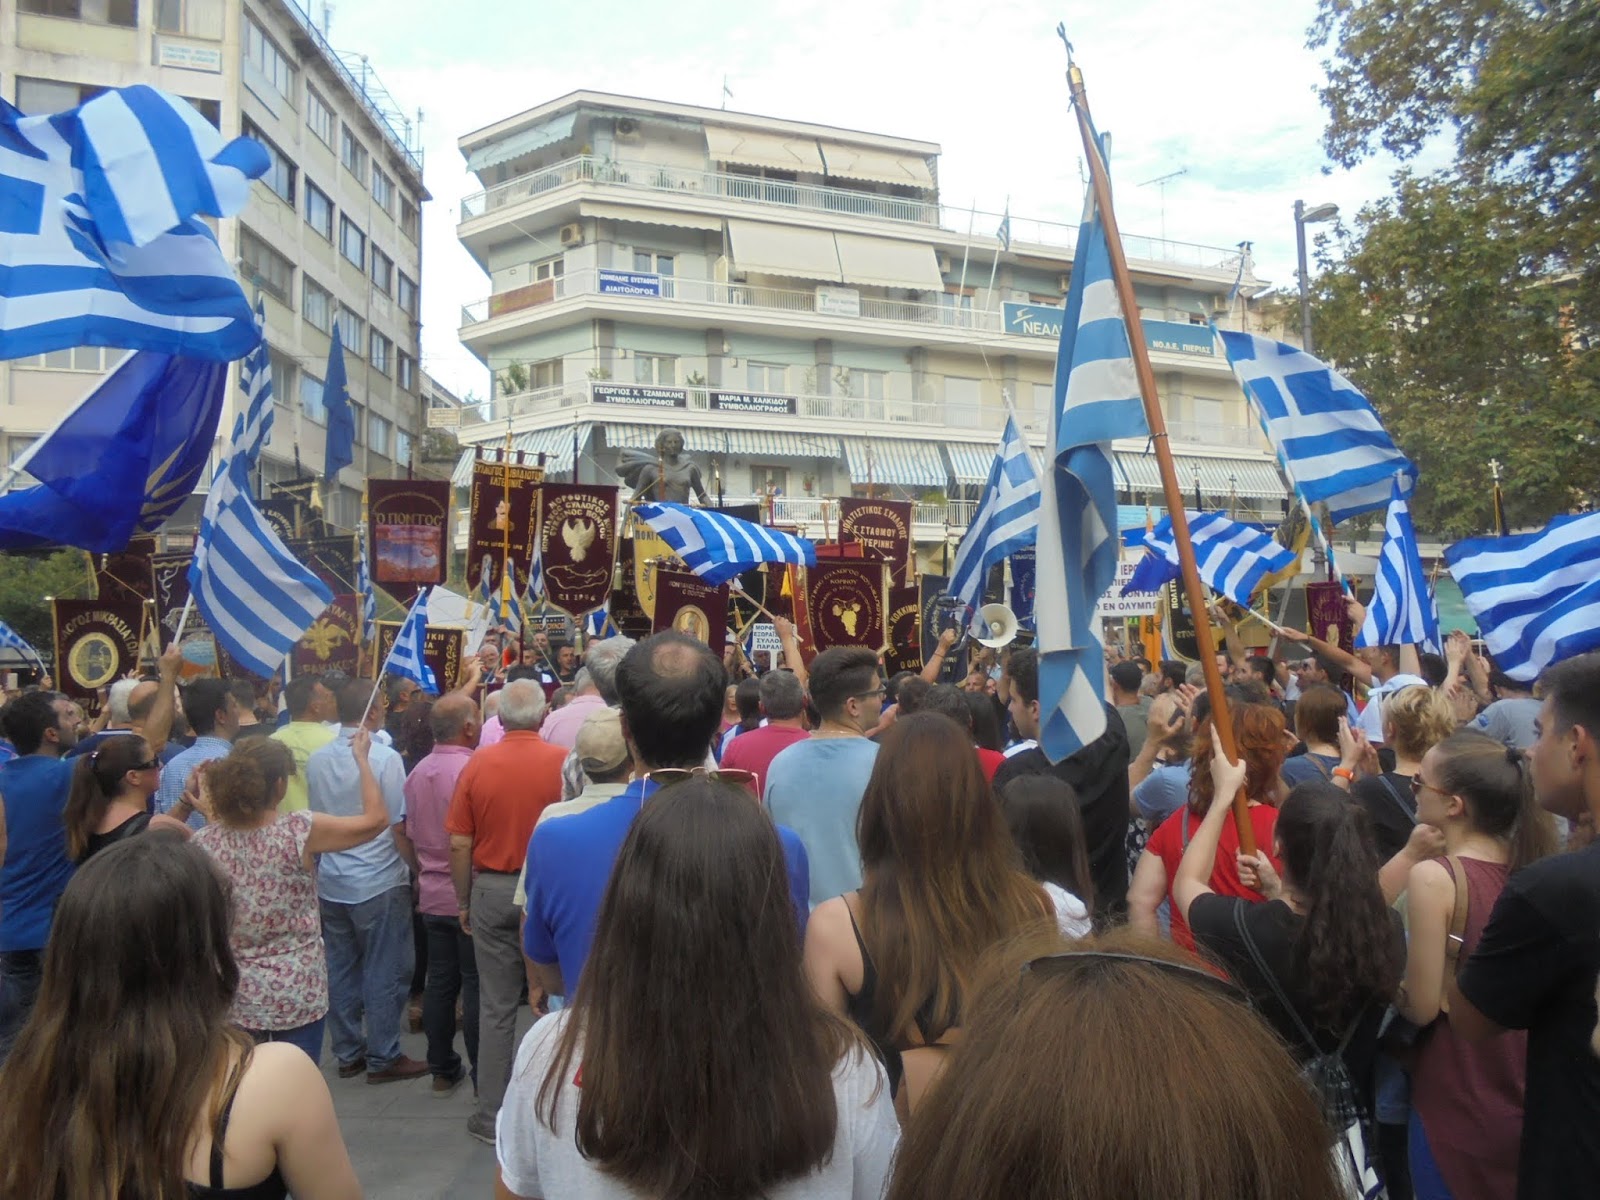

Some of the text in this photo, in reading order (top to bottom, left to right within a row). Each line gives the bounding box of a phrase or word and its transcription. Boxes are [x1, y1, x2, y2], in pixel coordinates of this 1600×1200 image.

[605, 285, 655, 295] ΔΙΑΙΤΟΛΟΓΟΣ
[1023, 320, 1062, 336] ΝΕΑΔ
[1182, 344, 1211, 354] ΠΙΕΡΙΑΣ
[594, 386, 631, 396] ΓΕΩΡΓΙΟΣ
[642, 389, 685, 399] ΤΖΑΜΑΚΛΗΣ
[605, 396, 675, 407] ΣΥΜΒΟΛΑΙΟΓΡΑΦΟΣ
[718, 394, 742, 402] ΜΑΡΙΑ
[753, 397, 788, 406] ΧΑΛΚΙΔΟΥ
[719, 402, 788, 413] ΣΥΜΒΟΛΑΙΟΓΡΑΦΟΣ
[489, 475, 524, 489] ΚΑΤΕΙΝΗΣ
[842, 505, 908, 540] ΠΟΛΙΤΙΣΤΙΚΟΣ ΣΥΛΛΟΓΟΣ
[860, 525, 896, 538] ΣΤΑΘΜΟΥ
[1103, 602, 1116, 611] ΕΝ
